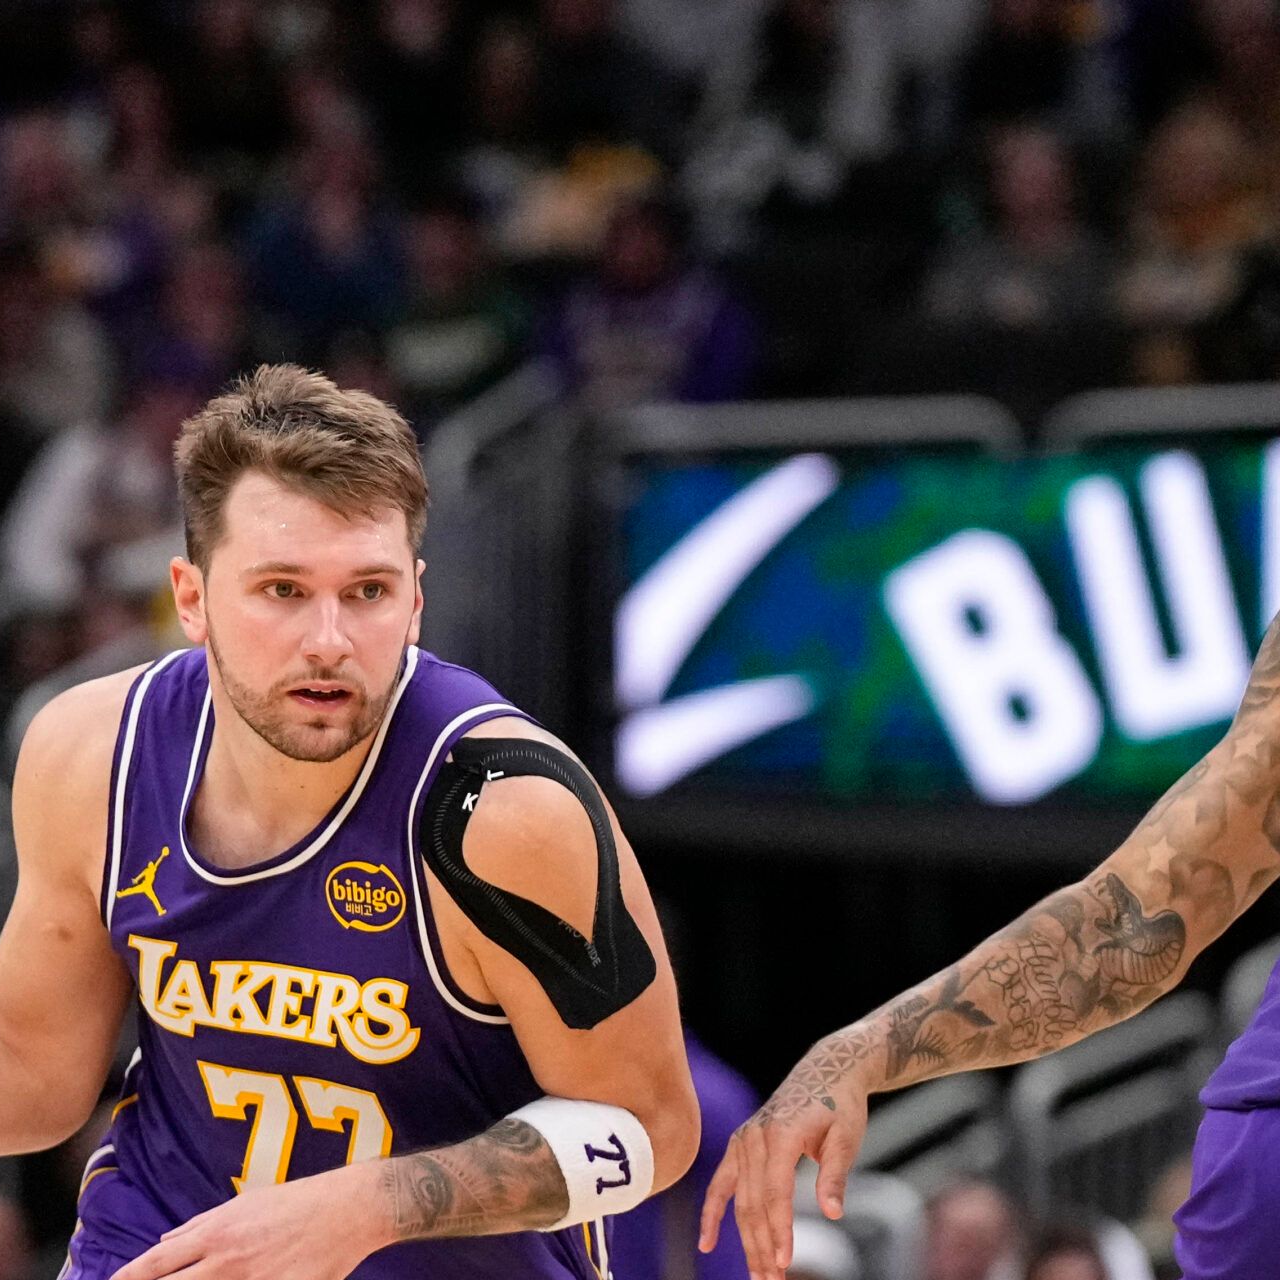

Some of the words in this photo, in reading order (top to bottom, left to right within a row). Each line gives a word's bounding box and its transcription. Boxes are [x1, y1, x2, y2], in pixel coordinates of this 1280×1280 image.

[332, 878, 401, 913] bibigo
[127, 933, 421, 1065] LAKERS
[196, 1059, 393, 1195] 77
[583, 1132, 631, 1195] 77
